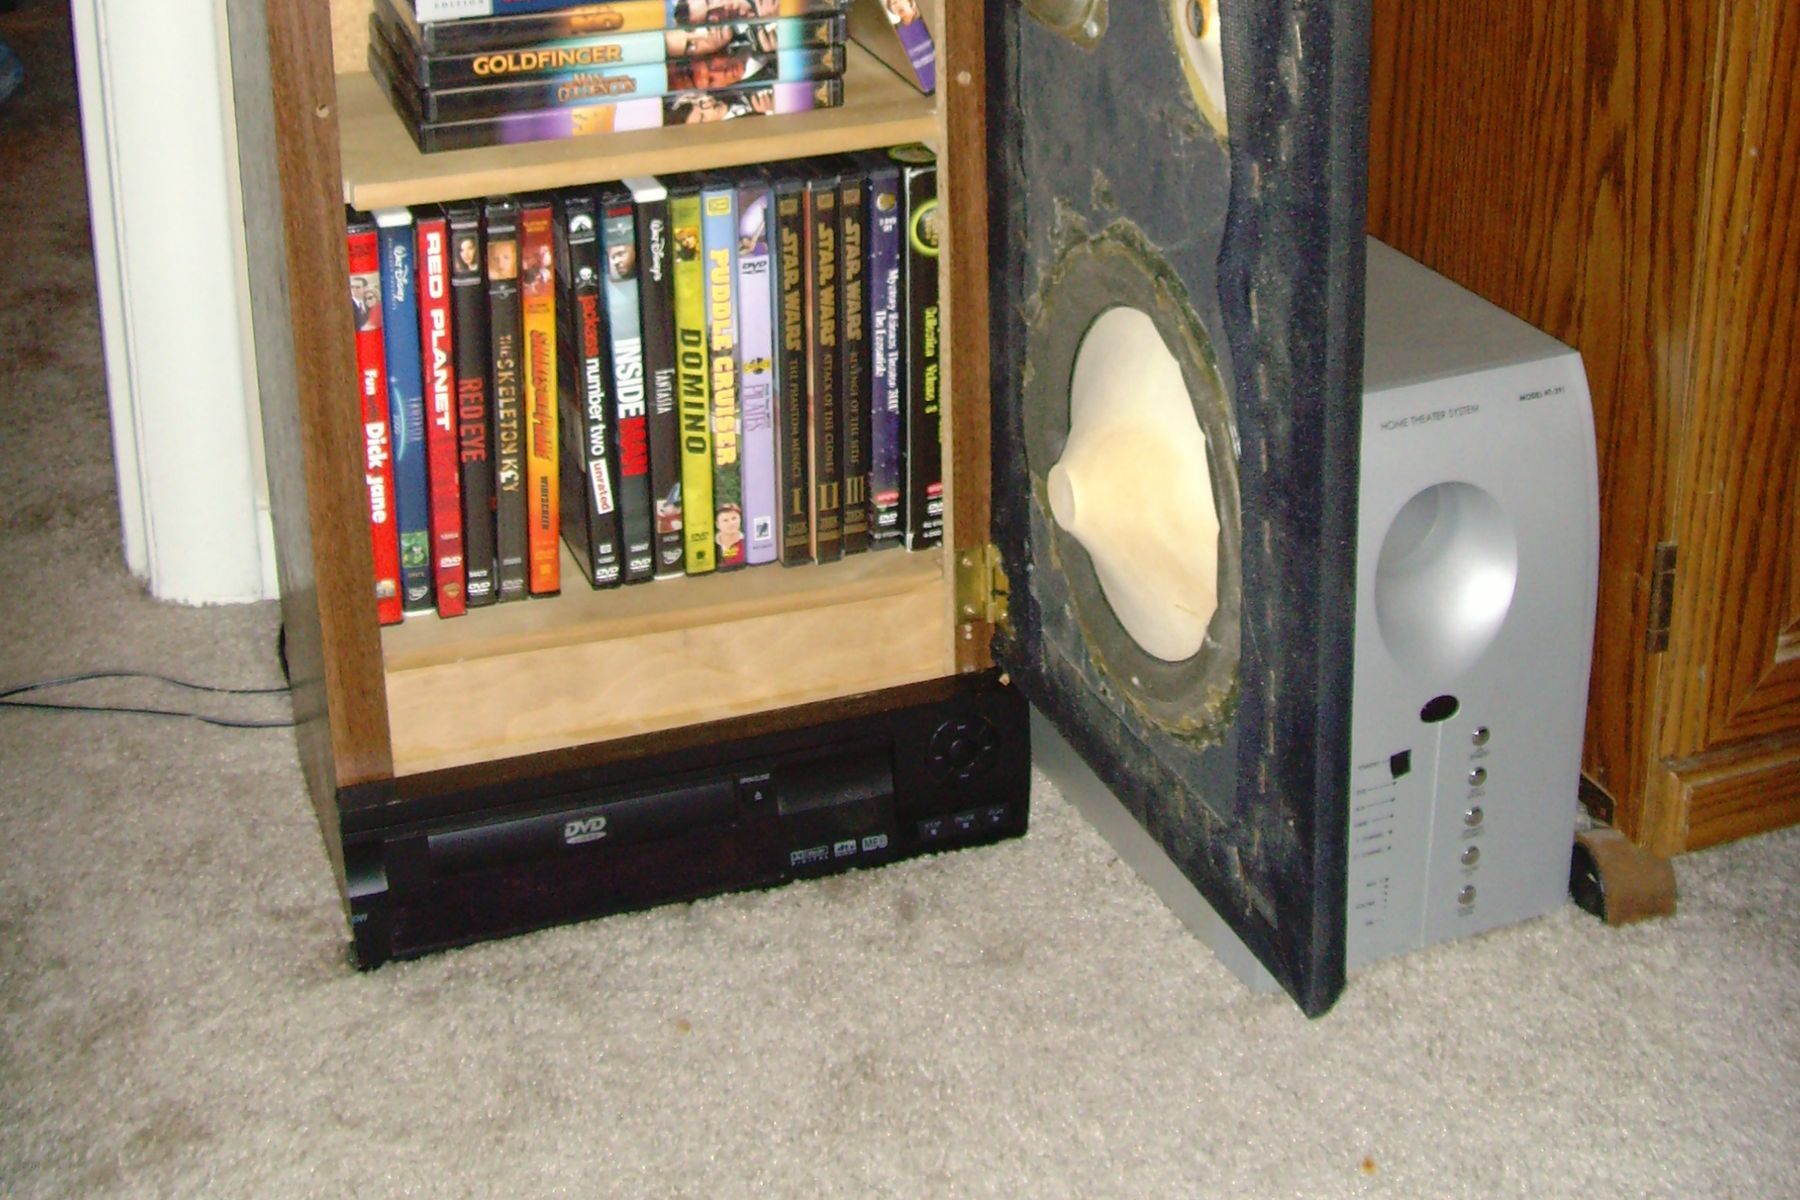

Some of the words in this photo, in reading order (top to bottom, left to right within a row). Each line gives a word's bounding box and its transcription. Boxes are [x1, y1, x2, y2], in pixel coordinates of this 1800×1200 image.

[433, 0, 486, 10] EDITION
[472, 44, 624, 76] GOLDFINGER
[426, 232, 445, 299] RED
[742, 260, 768, 274] DVD
[782, 227, 800, 290] STAR
[818, 222, 835, 286] STAR
[844, 216, 862, 280] STAR
[710, 248, 734, 352] PUDDLE
[846, 280, 862, 341] WARS
[886, 268, 899, 311] Mystery
[577, 294, 601, 358] jackass
[784, 290, 802, 352] WARS
[820, 285, 836, 347] WARS
[874, 310, 886, 328] The
[888, 312, 899, 349] Science
[500, 334, 513, 358] THE
[874, 328, 886, 378] Essentials
[364, 370, 378, 396] Fun
[429, 308, 450, 432] PLANET
[585, 358, 608, 420] number
[615, 338, 646, 418] INSIDE
[822, 352, 833, 392] ATTACK
[850, 352, 860, 396] REVENGE
[924, 364, 937, 402] Volume
[458, 376, 484, 420] RED
[498, 359, 518, 454] SKELETON
[680, 329, 706, 455] DOMINO
[714, 356, 737, 466] CRUISER
[790, 383, 801, 435] PHANTOM
[824, 394, 833, 408] OF
[850, 399, 860, 412] OF
[1380, 417, 1409, 430] HOME
[1410, 410, 1446, 426] THEATER
[1449, 404, 1480, 418] SYSTEM
[365, 422, 388, 470] Dick
[460, 424, 486, 464] EYE
[589, 424, 606, 456] two
[790, 438, 802, 481] MENACE
[824, 433, 834, 474] CLONES
[851, 440, 860, 464] SITH
[500, 458, 520, 492] KEY
[594, 462, 610, 510] unrated
[818, 481, 840, 512] II
[846, 476, 866, 505] III
[540, 475, 550, 530] WIDESCREEN
[792, 487, 802, 515] I
[564, 816, 608, 838] DVD
